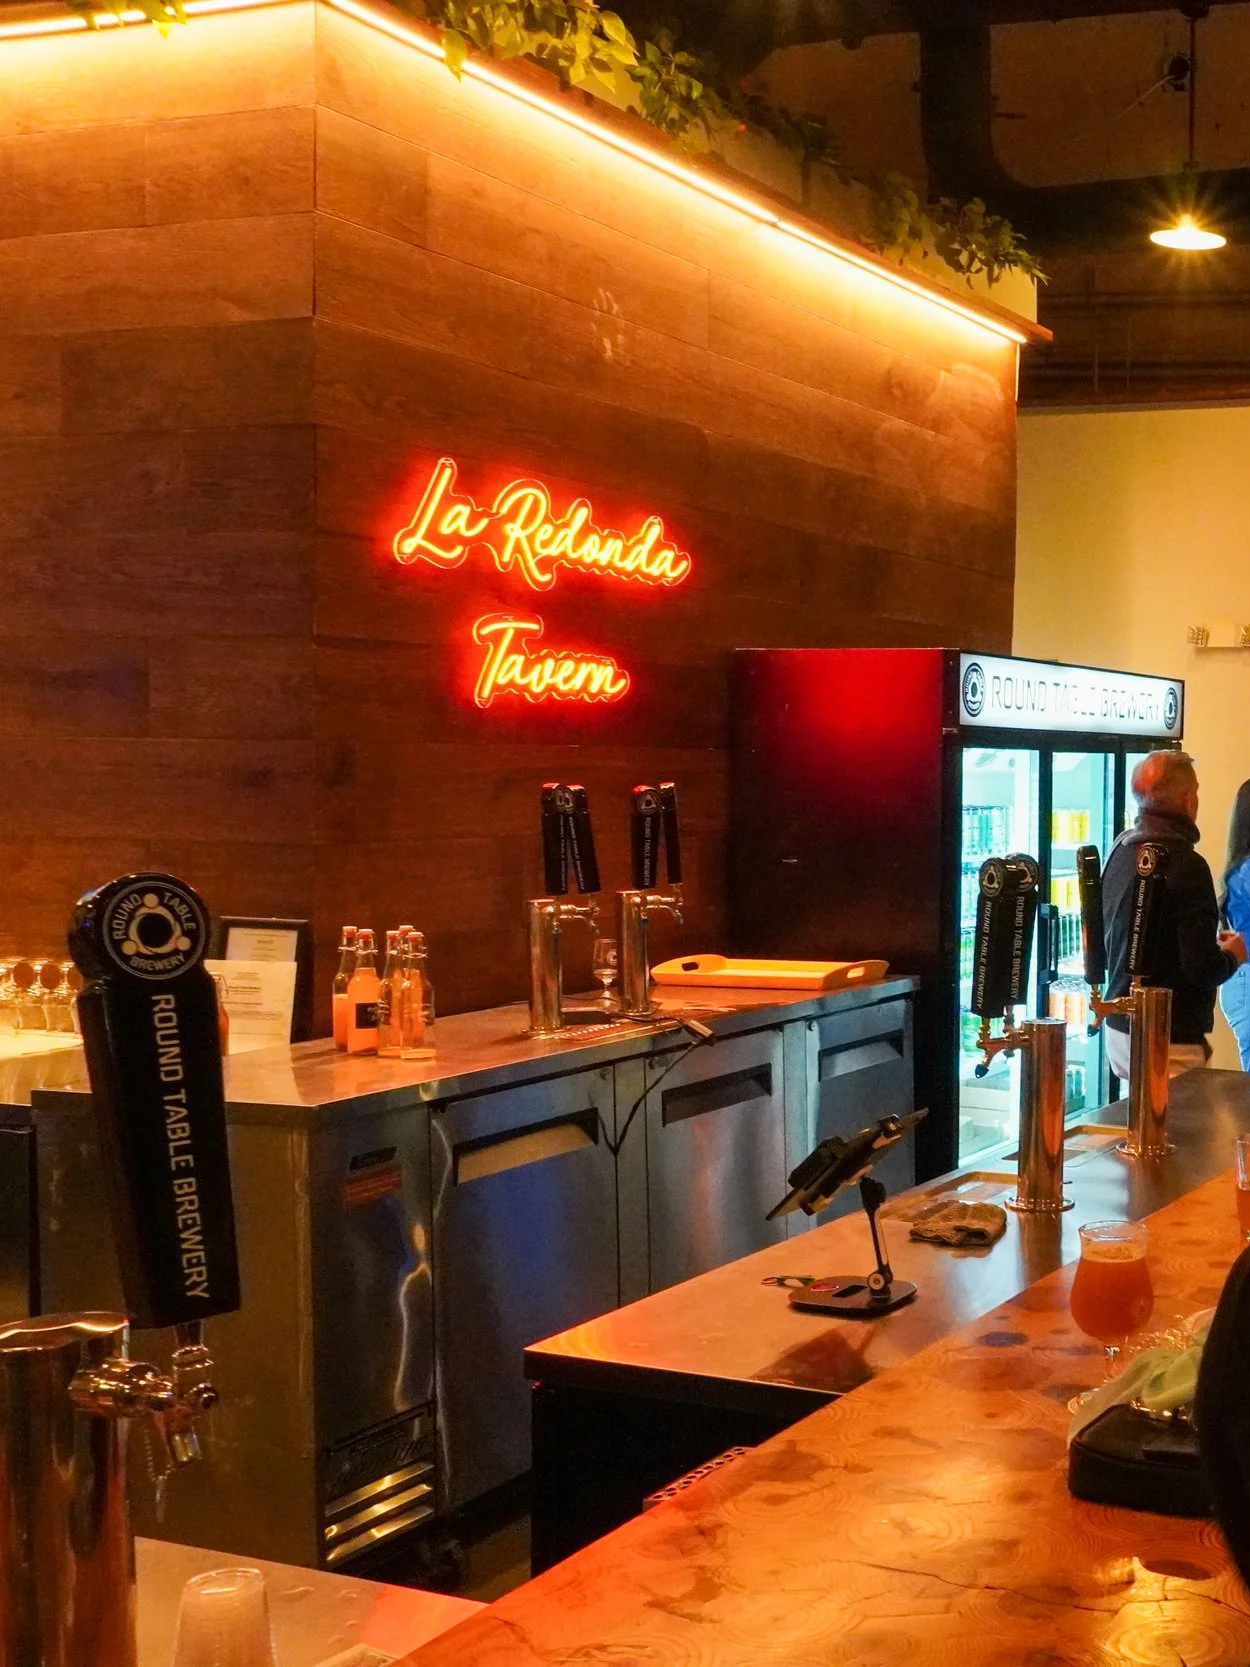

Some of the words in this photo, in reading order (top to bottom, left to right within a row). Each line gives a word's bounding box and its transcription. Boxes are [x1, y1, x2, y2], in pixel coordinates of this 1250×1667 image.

[399, 463, 489, 560] La
[498, 485, 689, 583] Redonda
[478, 620, 628, 699] Tavern
[991, 675, 1047, 713] ROUND
[1053, 682, 1096, 717] TABE
[163, 892, 196, 931] TABLE
[1015, 896, 1025, 927] ROUND
[1137, 879, 1146, 907] ROUND
[111, 893, 142, 940] ROUND
[982, 900, 992, 934] ROUND
[130, 953, 185, 971] BREWERY
[980, 935, 989, 965] TABLE
[1013, 929, 1023, 957] TABLE
[976, 965, 986, 1010] BREWERY
[1010, 958, 1021, 999] BREWERY
[152, 994, 185, 1082] ROUND
[163, 1088, 194, 1170] TABLE
[173, 1179, 211, 1300] BREWERY
